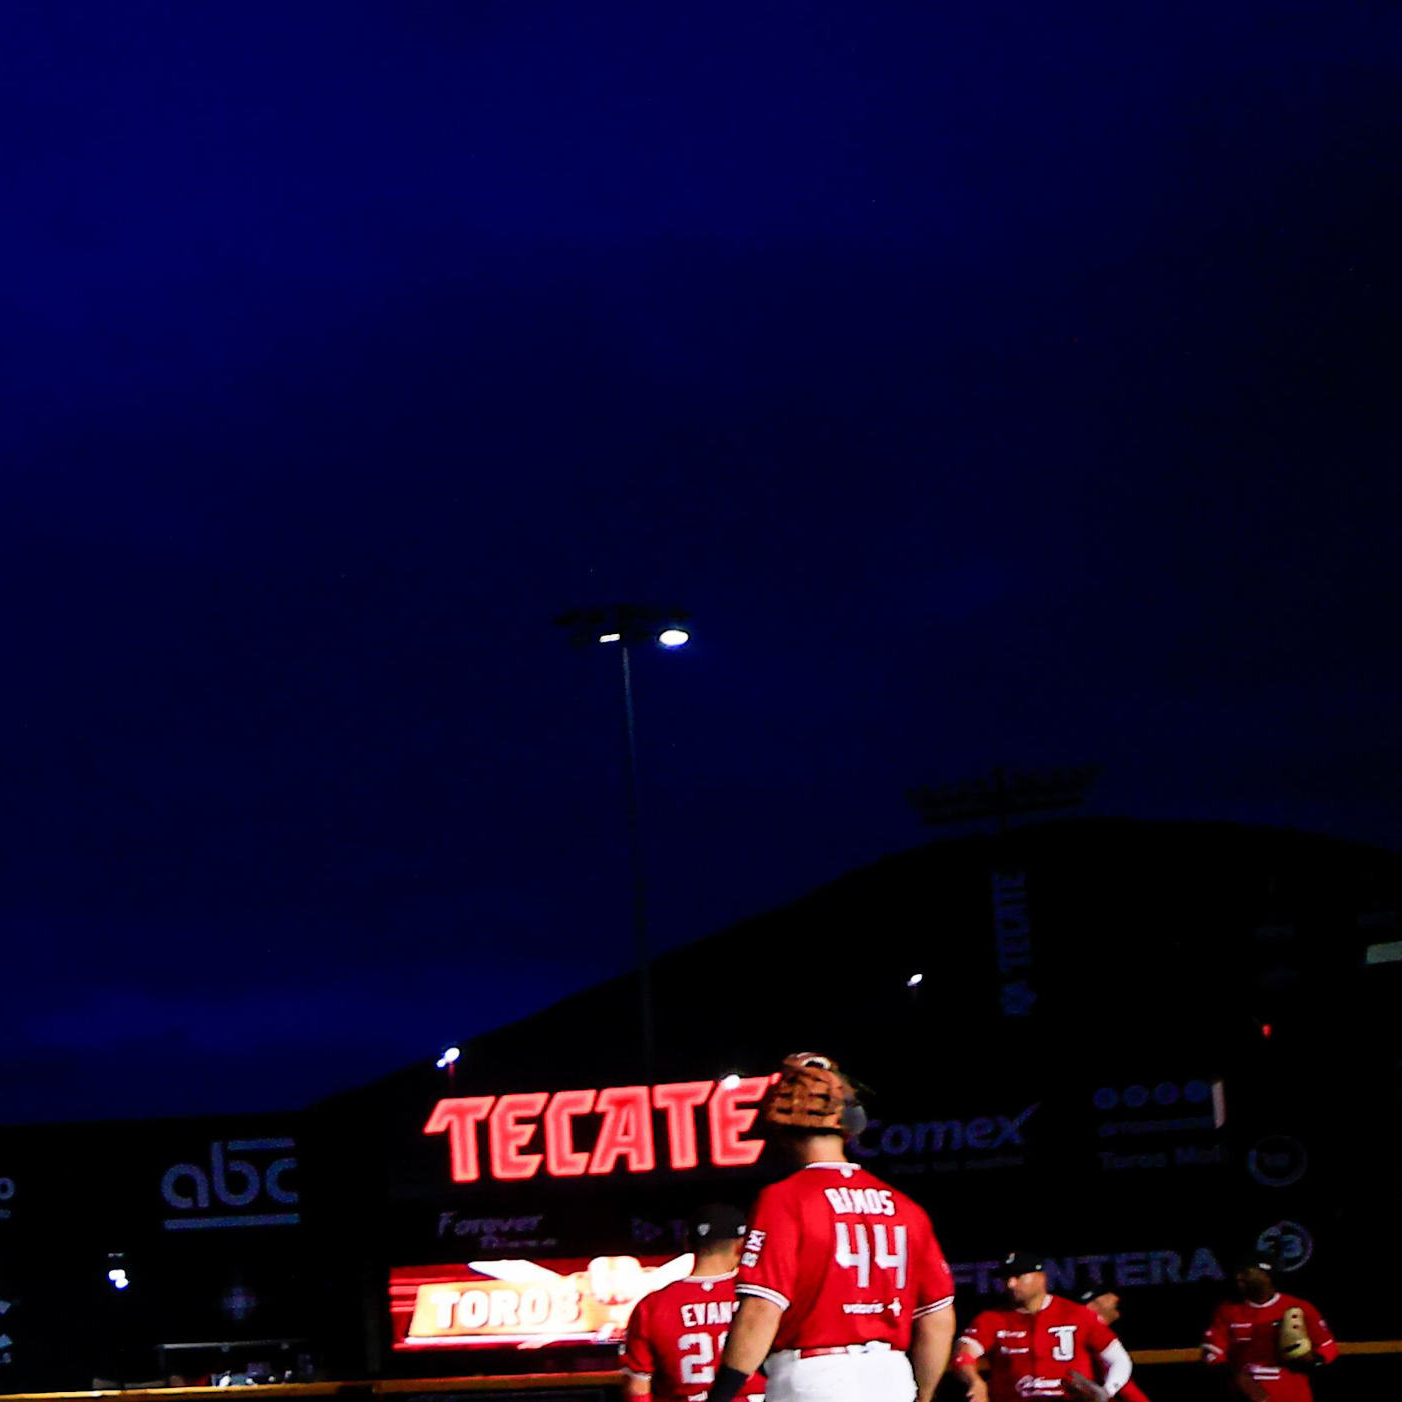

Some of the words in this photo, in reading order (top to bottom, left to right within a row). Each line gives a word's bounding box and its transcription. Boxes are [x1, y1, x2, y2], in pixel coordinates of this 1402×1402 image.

[423, 1073, 776, 1184] TECATE
[160, 1138, 300, 1211] abc
[824, 1187, 895, 1216] RAMOS
[834, 1221, 908, 1289] 44
[950, 1245, 1227, 1295] FRNTERA
[428, 1289, 582, 1329] TOROS
[677, 1331, 729, 1384] 2
